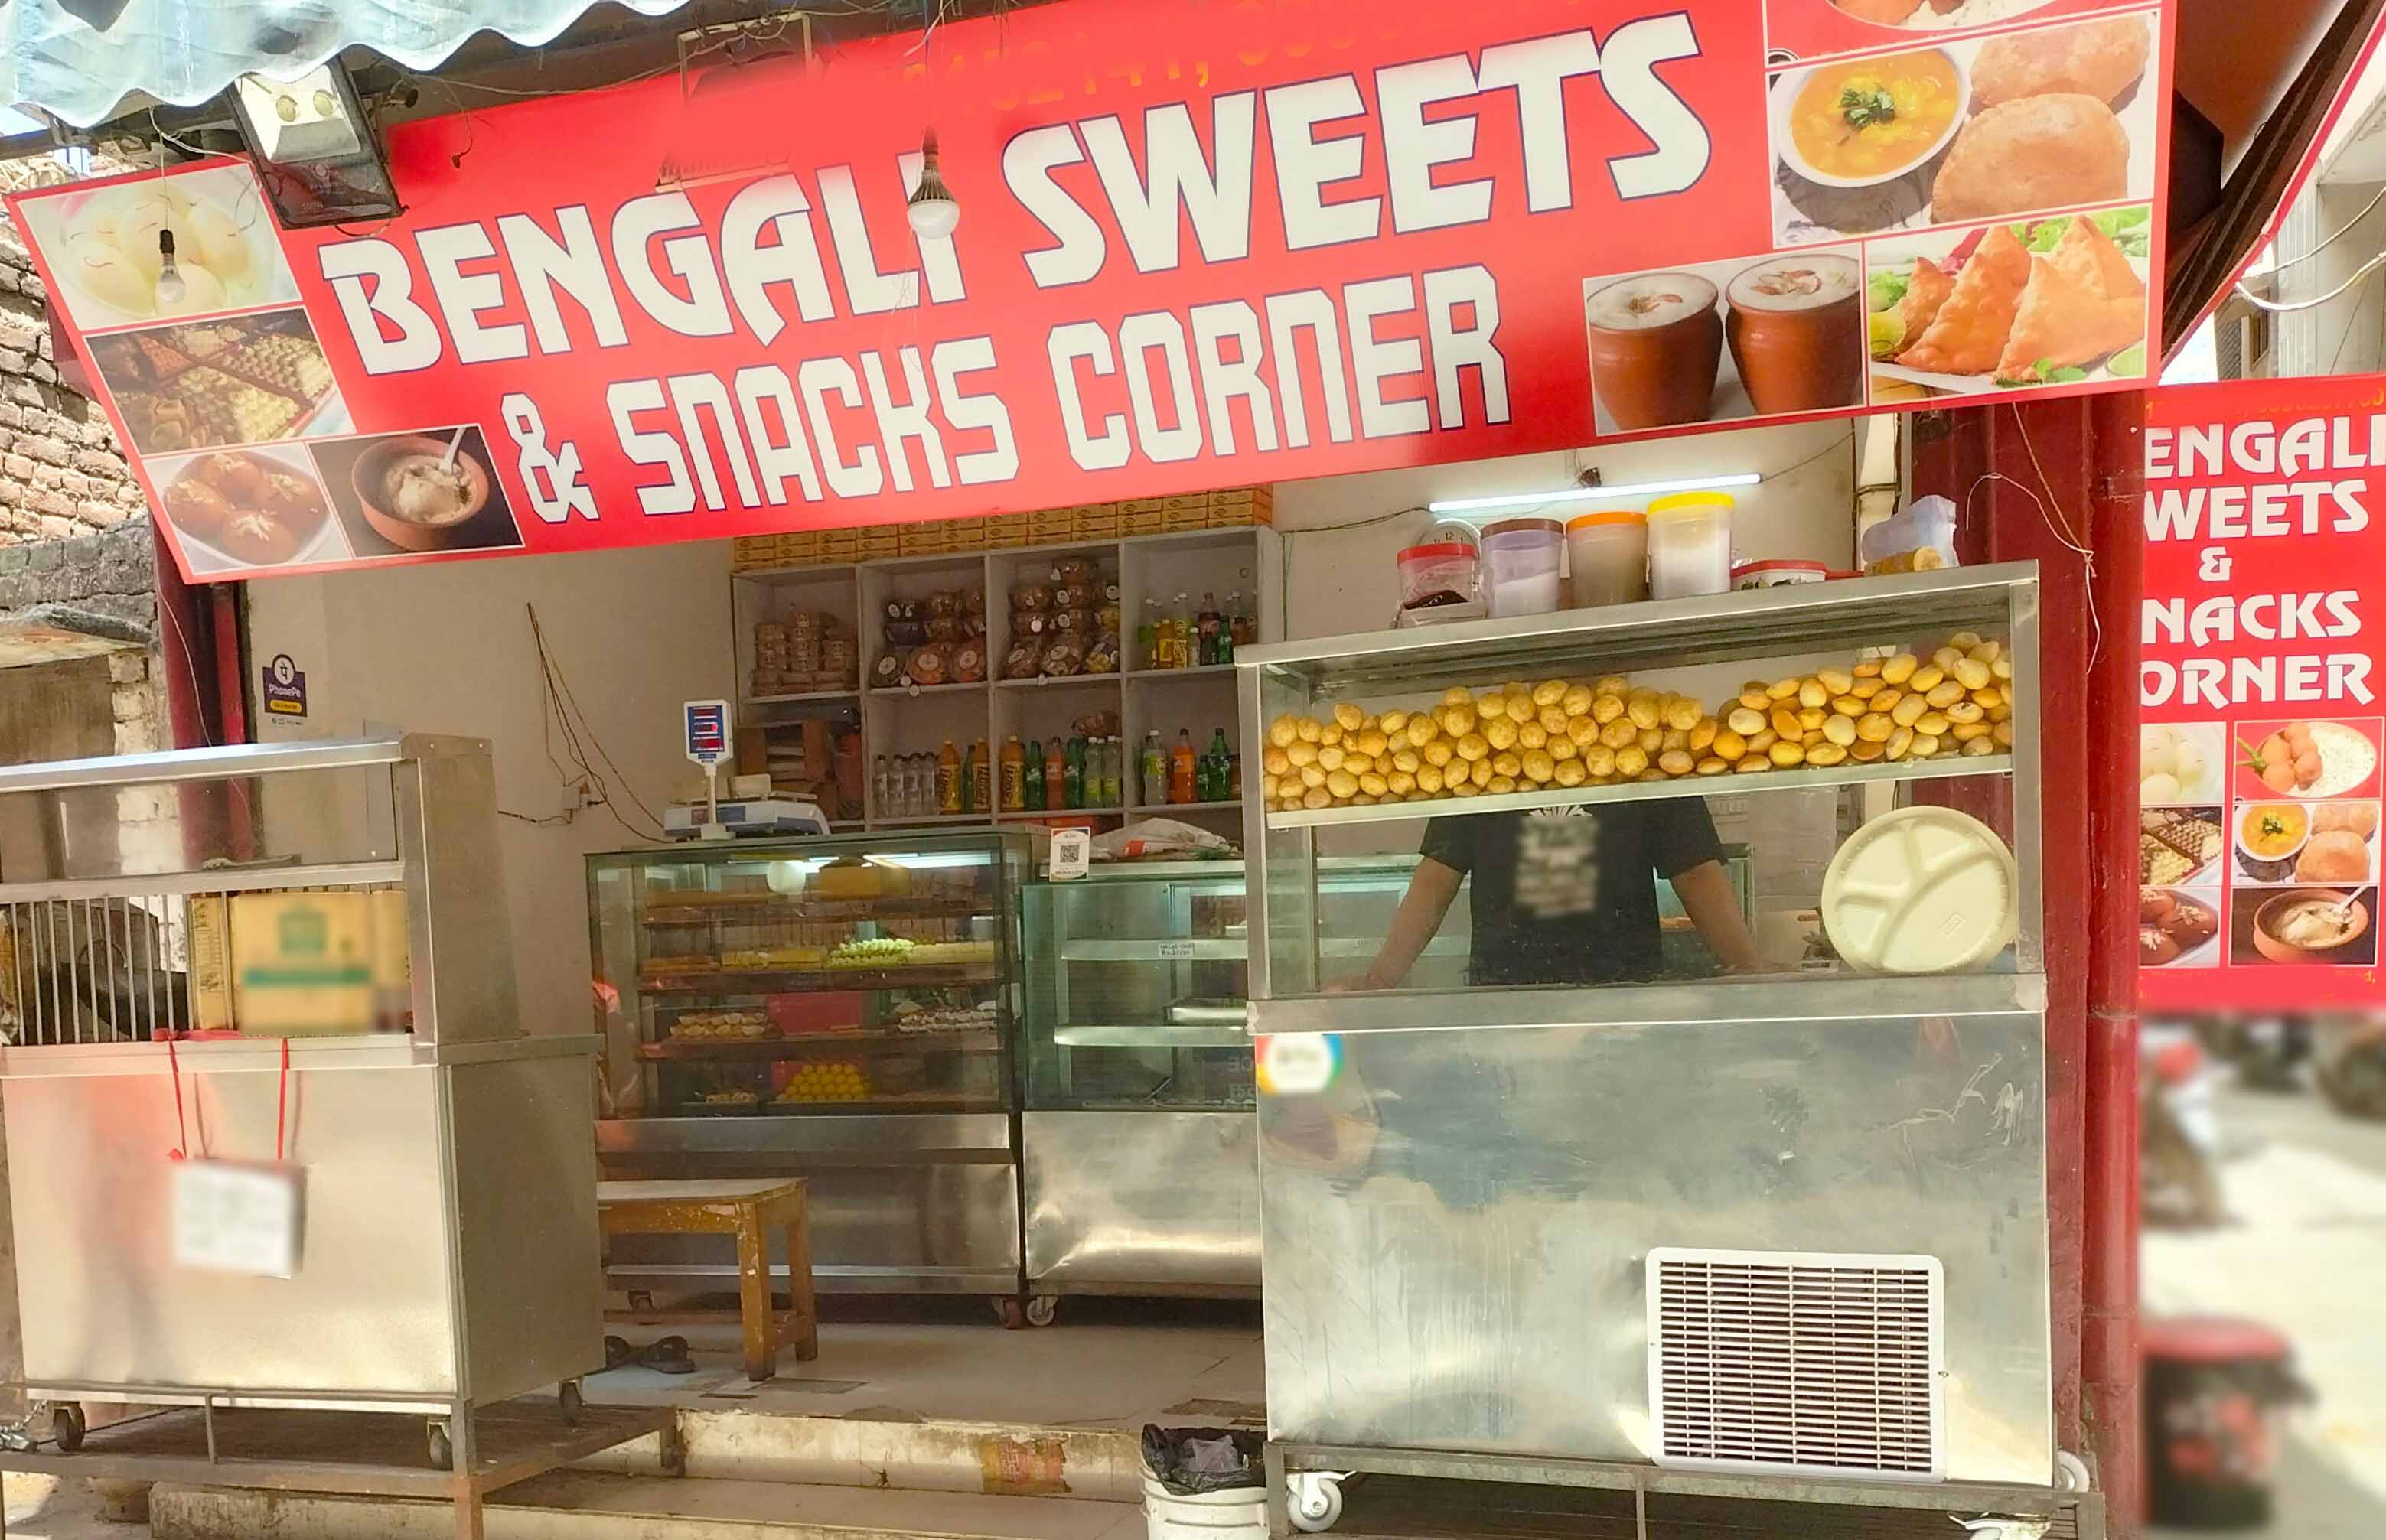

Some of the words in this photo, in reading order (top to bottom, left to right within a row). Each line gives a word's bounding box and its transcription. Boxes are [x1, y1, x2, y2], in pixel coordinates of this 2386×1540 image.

[317, 151, 967, 376] BENGALI
[1002, 10, 1712, 290] SWEETS
[499, 392, 601, 523] &
[605, 335, 1021, 516] SNACKS
[1045, 263, 1511, 472] CORNER
[2143, 413, 2386, 479] ENGALI
[2143, 477, 2370, 542] WEETS
[2198, 545, 2233, 582] &
[2140, 588, 2362, 648] NACKS
[269, 683, 301, 698] PhonePe
[2140, 653, 2376, 711] ORNER
